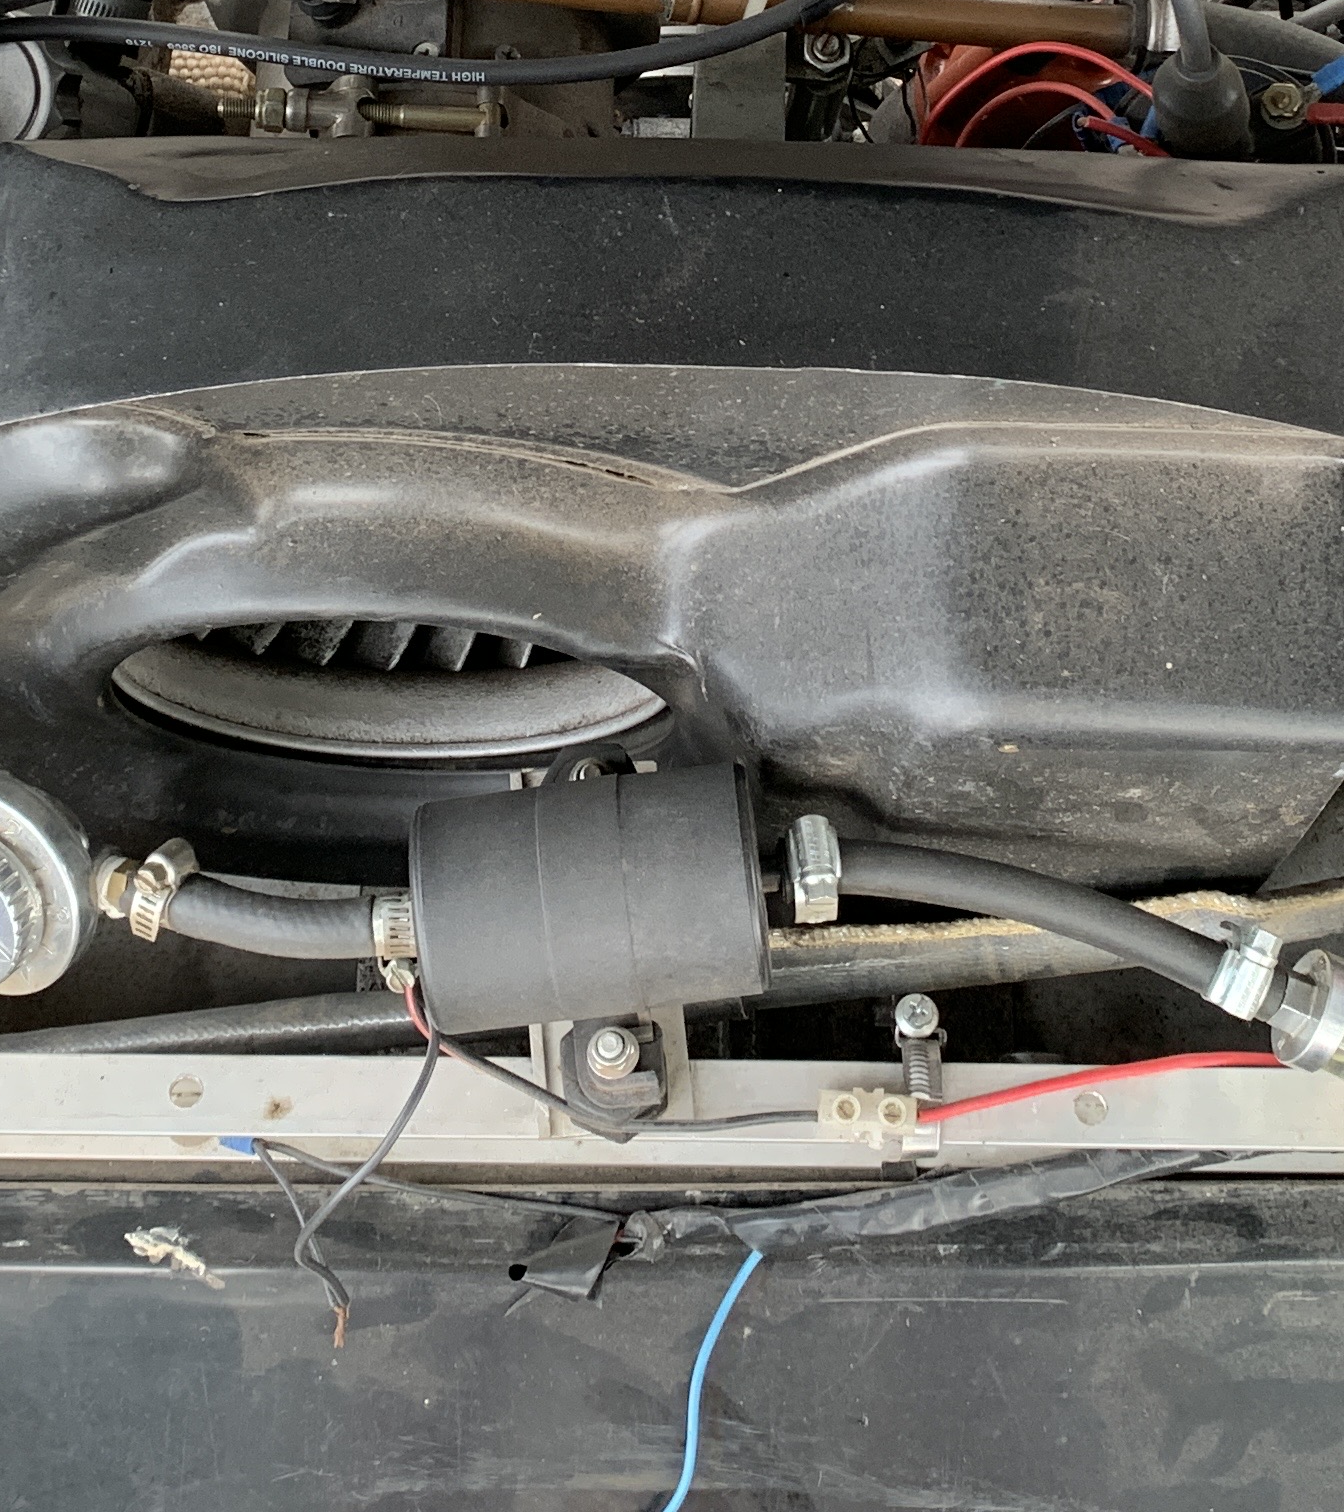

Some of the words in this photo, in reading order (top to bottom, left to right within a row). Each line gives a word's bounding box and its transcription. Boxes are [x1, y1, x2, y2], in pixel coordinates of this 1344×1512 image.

[198, 44, 222, 55] ISO
[228, 46, 289, 65] SILICONE
[292, 55, 346, 72] DOUBLE
[350, 63, 448, 81] TEMPERATURE
[451, 71, 485, 82] HIGH
